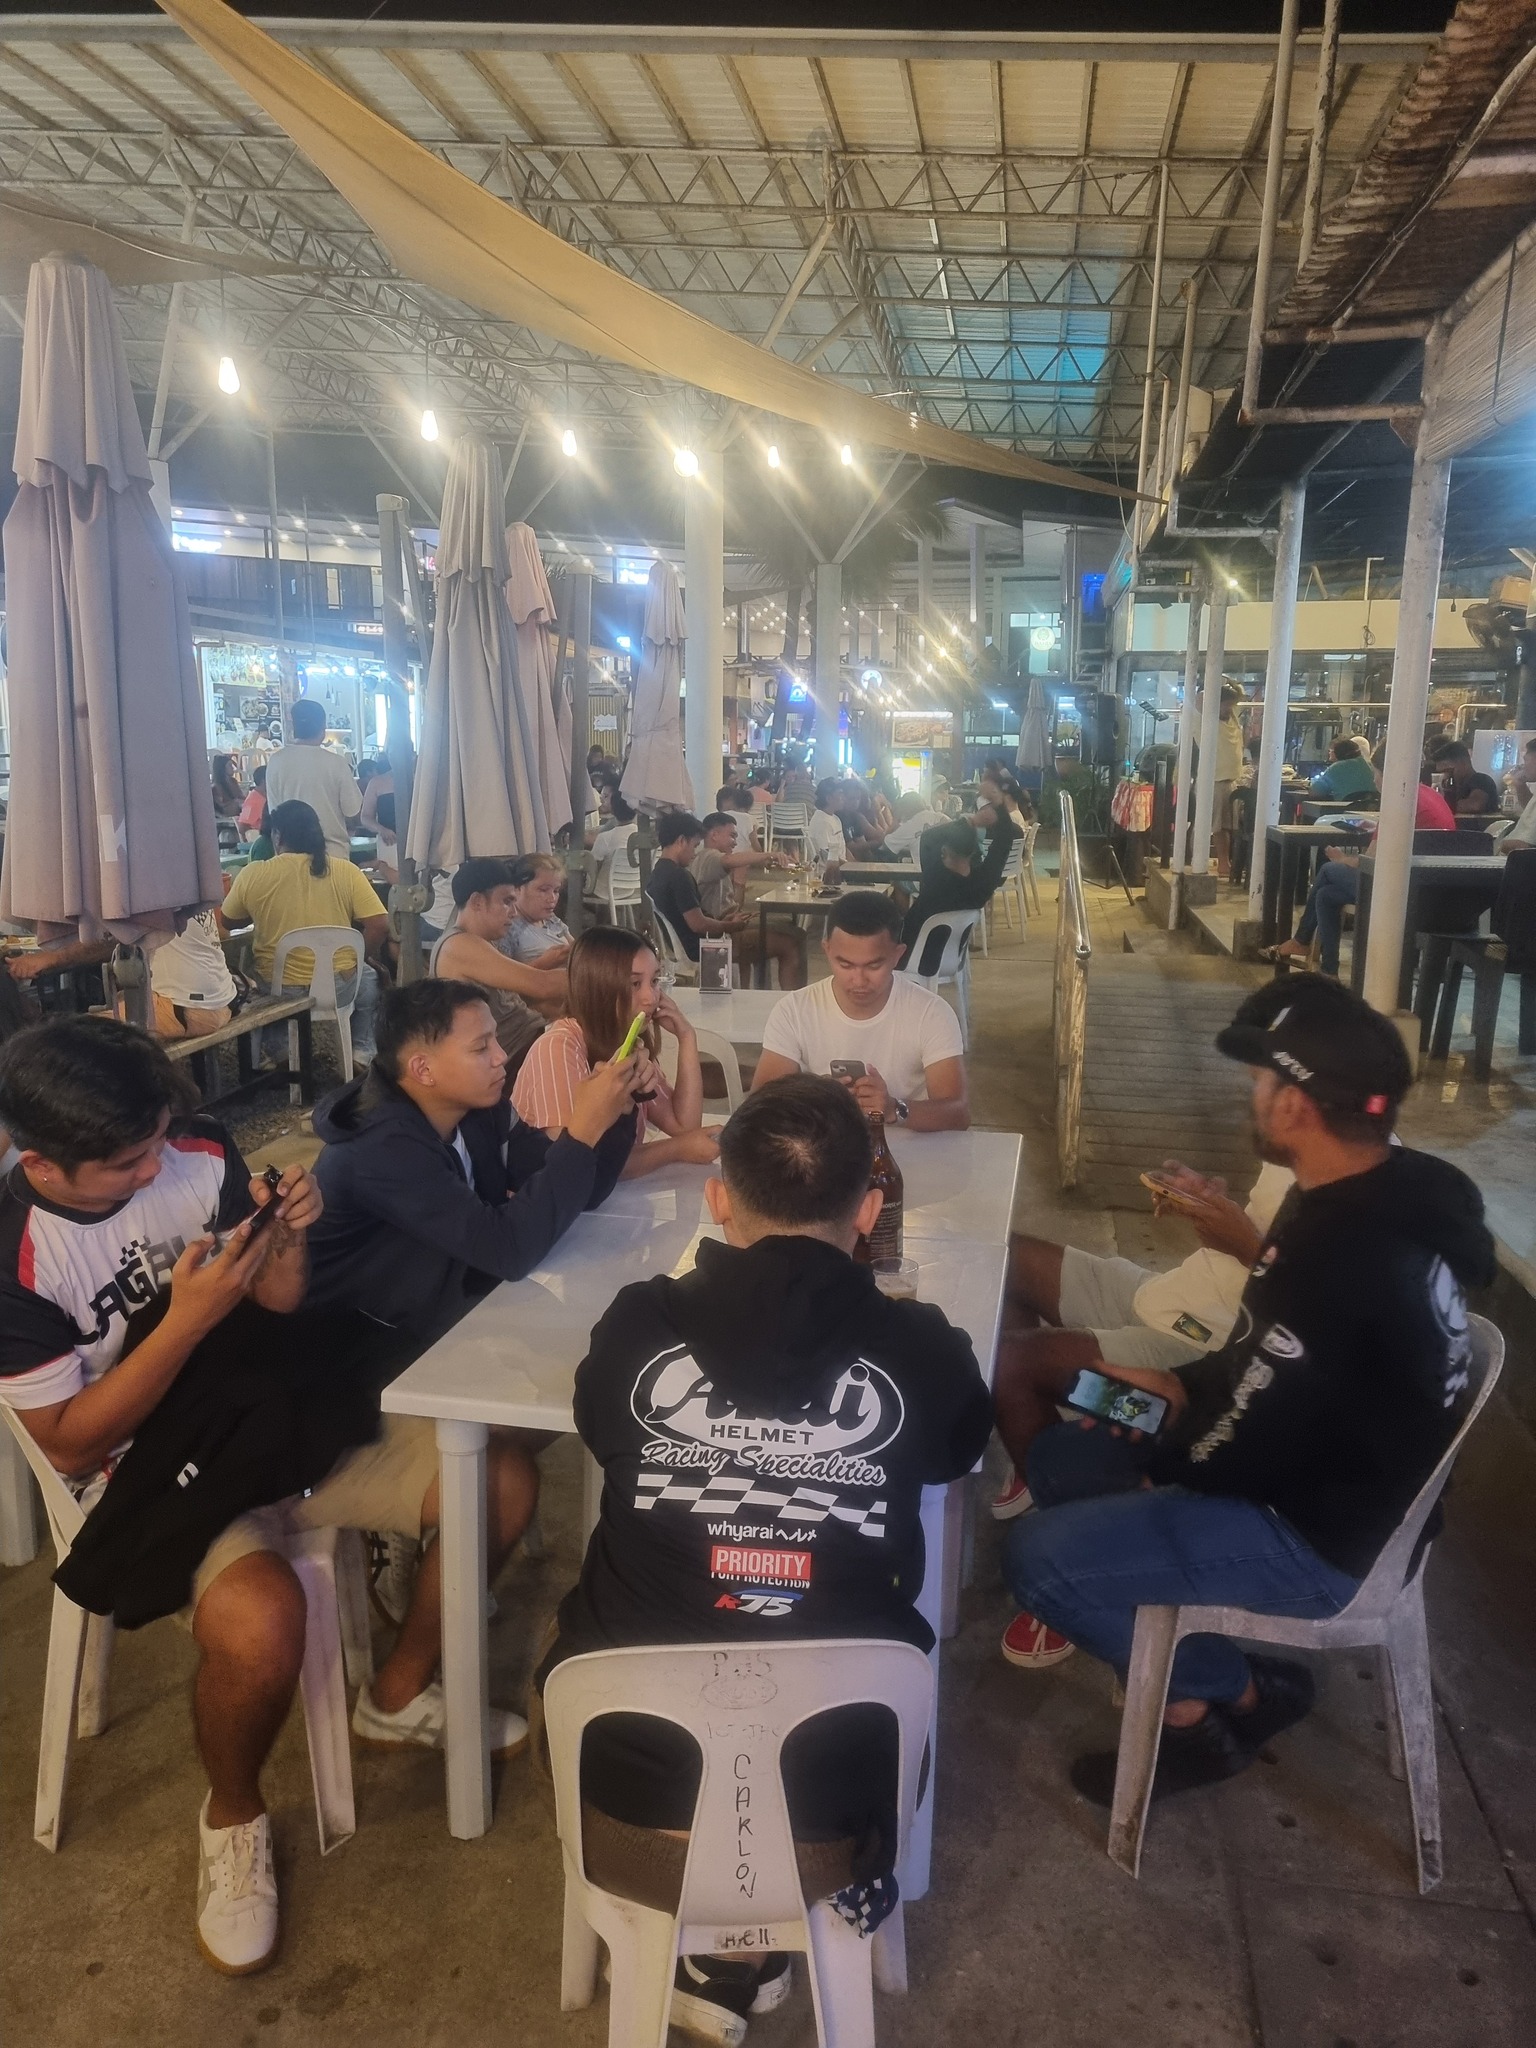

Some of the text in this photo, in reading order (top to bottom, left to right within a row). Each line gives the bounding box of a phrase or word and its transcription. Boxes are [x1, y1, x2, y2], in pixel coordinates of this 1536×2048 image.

[710, 1424, 814, 1446] HELMET
[641, 1438, 887, 1487] Racing Specialities
[707, 1520, 774, 1542] whyarai
[715, 1549, 807, 1577] PRIORITY
